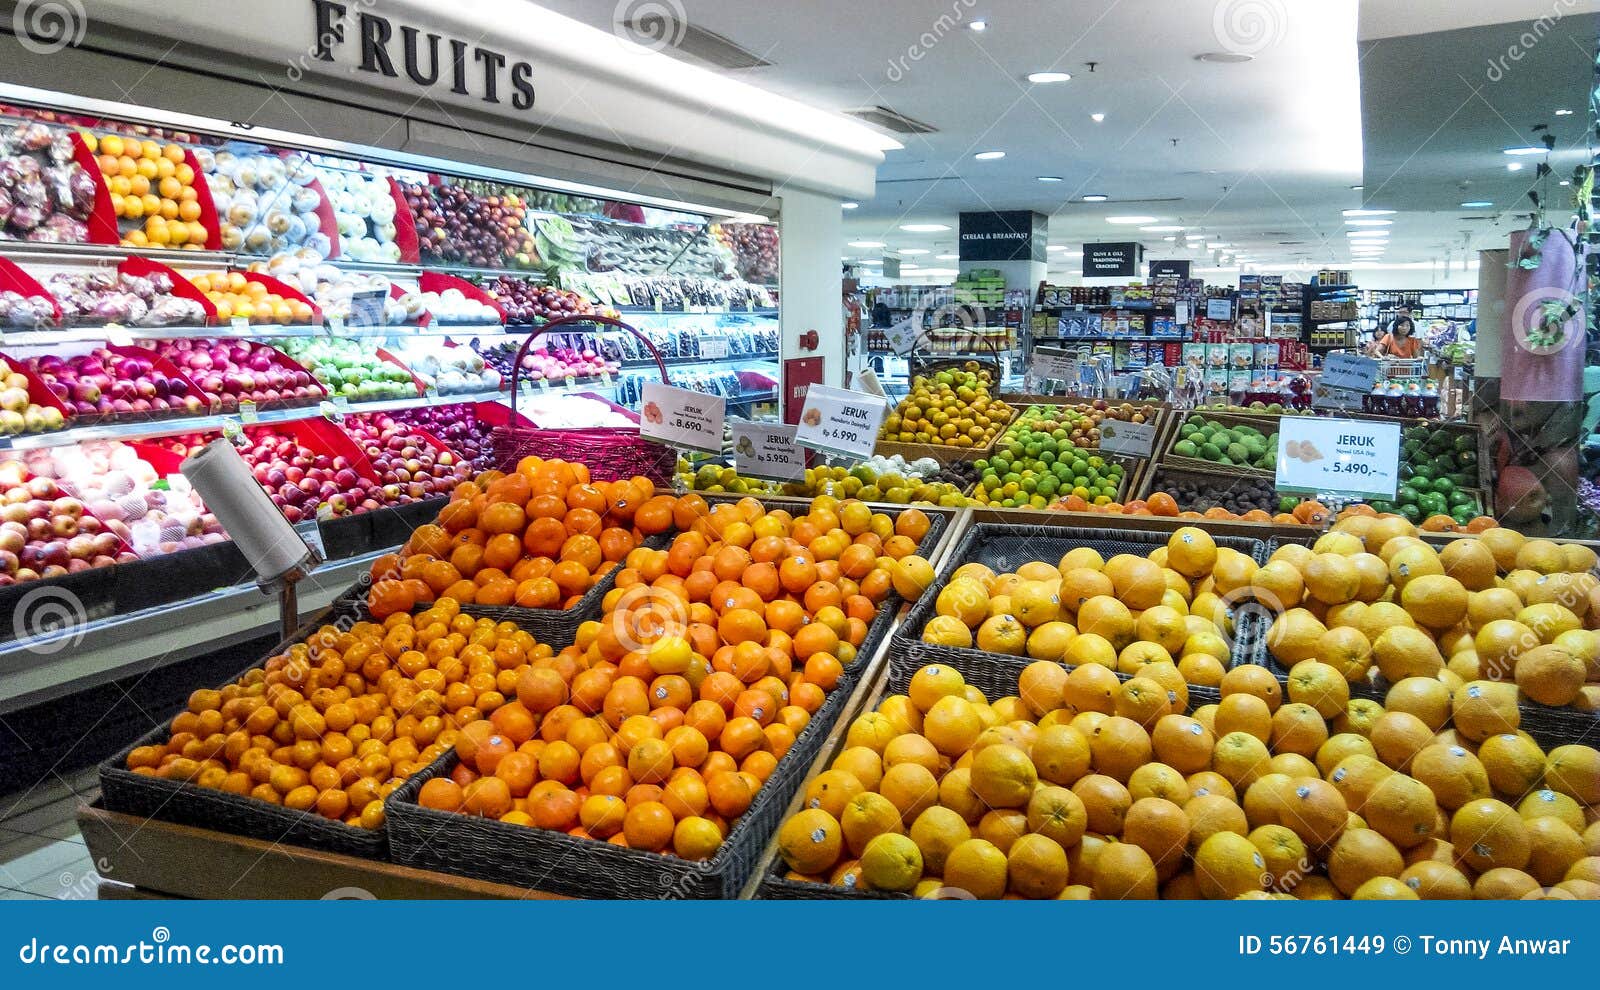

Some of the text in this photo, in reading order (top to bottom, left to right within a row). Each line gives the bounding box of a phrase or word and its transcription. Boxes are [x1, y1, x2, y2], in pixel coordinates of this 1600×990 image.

[312, 0, 536, 110] FRUITS
[962, 232, 984, 240] CEREAL
[993, 232, 1028, 240] BREAKFAST
[684, 405, 703, 415] JERUK
[840, 406, 869, 420] JERUK
[676, 418, 702, 432] 8.690
[766, 434, 791, 446] JERUK
[832, 429, 857, 442] 6.990
[1336, 434, 1375, 448] JERUK
[766, 453, 789, 464] 5.950
